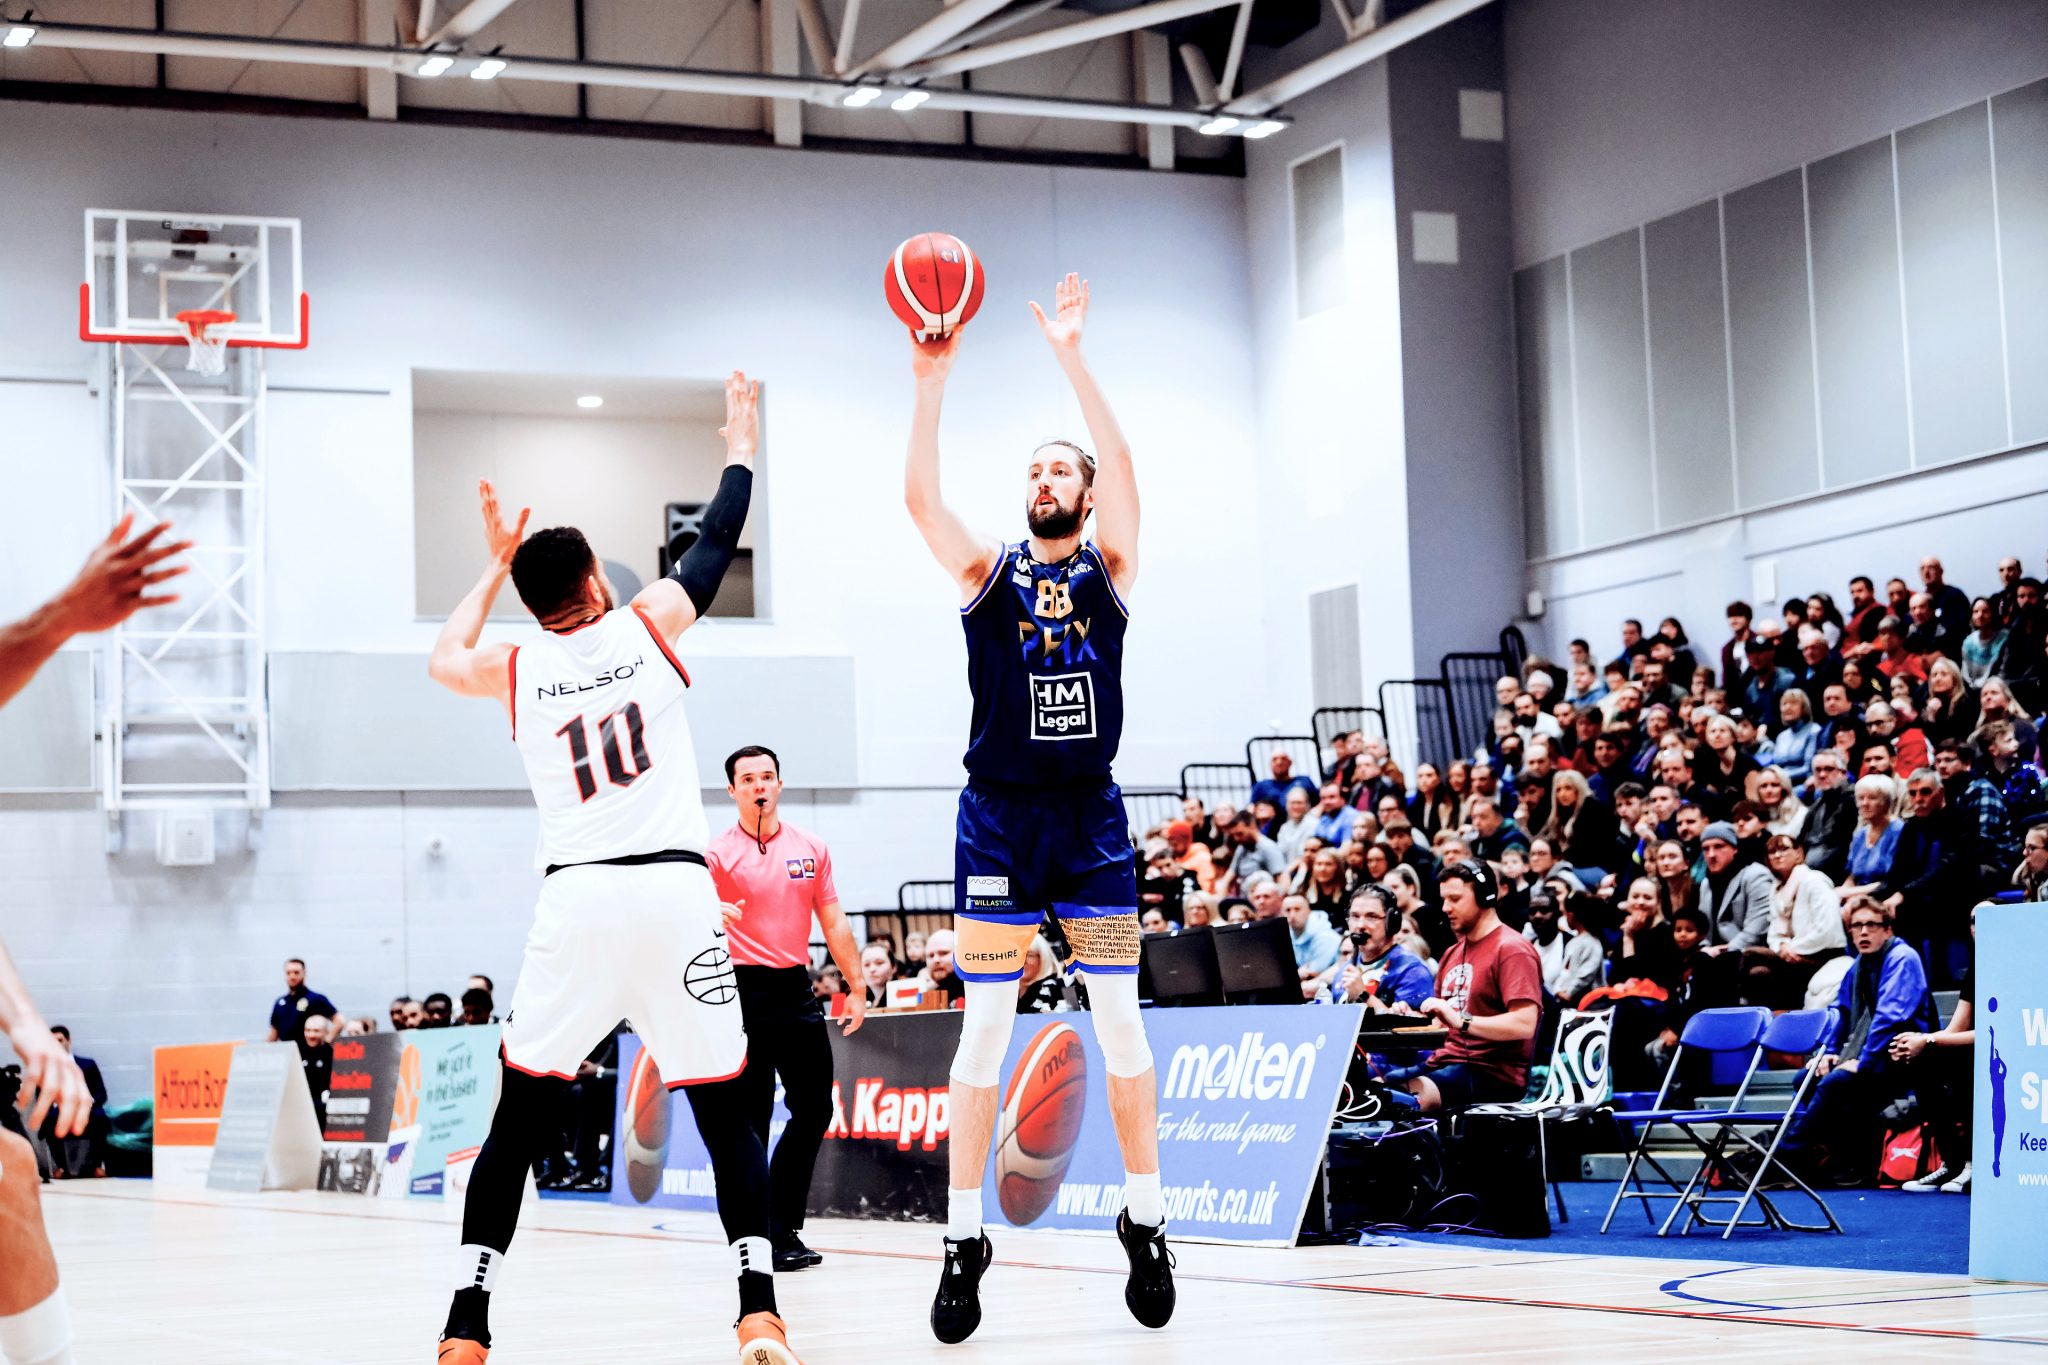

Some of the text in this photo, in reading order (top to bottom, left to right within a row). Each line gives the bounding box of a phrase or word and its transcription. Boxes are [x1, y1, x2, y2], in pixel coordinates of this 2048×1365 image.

[1034, 579, 1074, 619] 88
[538, 654, 644, 700] NELSON
[1034, 681, 1086, 705] HM
[1039, 710, 1086, 732] Legal
[555, 701, 653, 804] 10
[974, 899, 1013, 907] WILLASTON
[965, 949, 1017, 961] CHESHIRE
[1163, 1032, 1318, 1101] molten
[2021, 1071, 2048, 1123] S
[1157, 1110, 1297, 1155] For the real game
